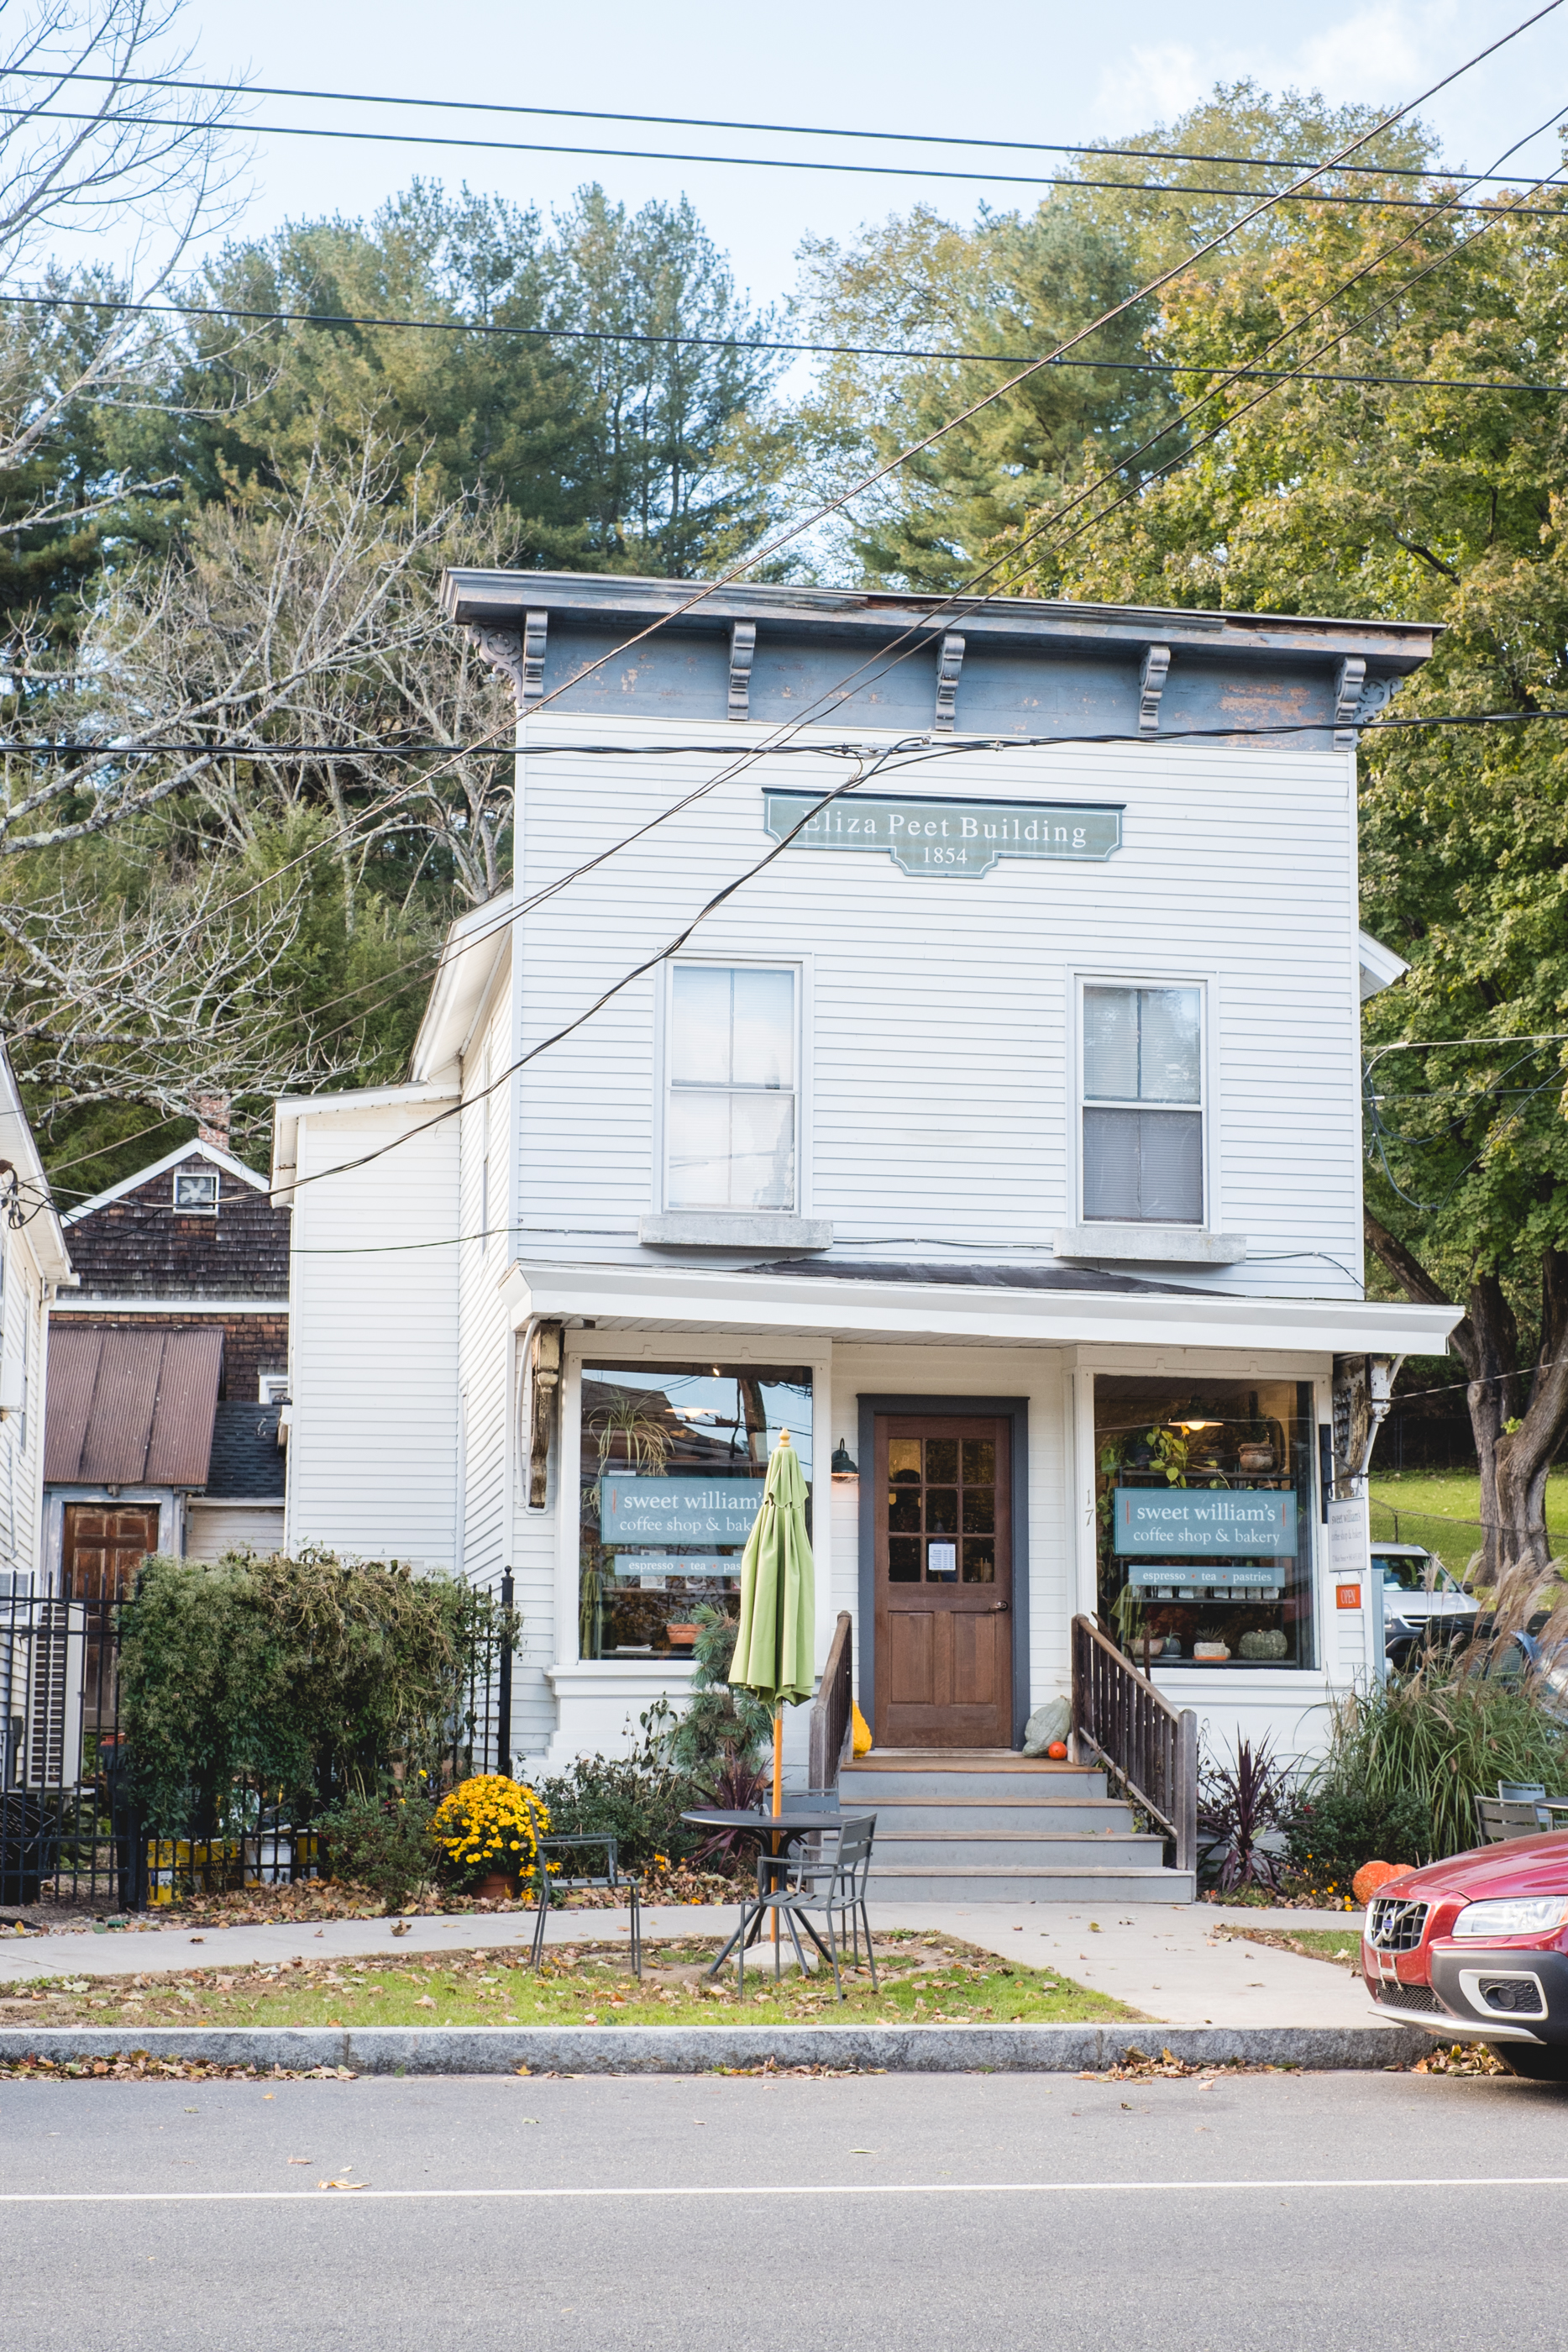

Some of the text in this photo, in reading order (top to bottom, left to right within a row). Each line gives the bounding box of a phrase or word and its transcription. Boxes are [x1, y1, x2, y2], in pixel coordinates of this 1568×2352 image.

[801, 810, 1087, 848] Eliza Peet Building
[924, 847, 968, 864] 1854
[623, 1491, 765, 1509] sweet william'
[1136, 1502, 1276, 1522] sweet william's
[620, 1516, 756, 1535] coffee shop & bak
[1134, 1526, 1281, 1546] coffee shop & bakery
[628, 1561, 741, 1573] espresso tea pas
[1142, 1571, 1272, 1583] espresso tea pastries
[1340, 1589, 1356, 1604] OPEN
